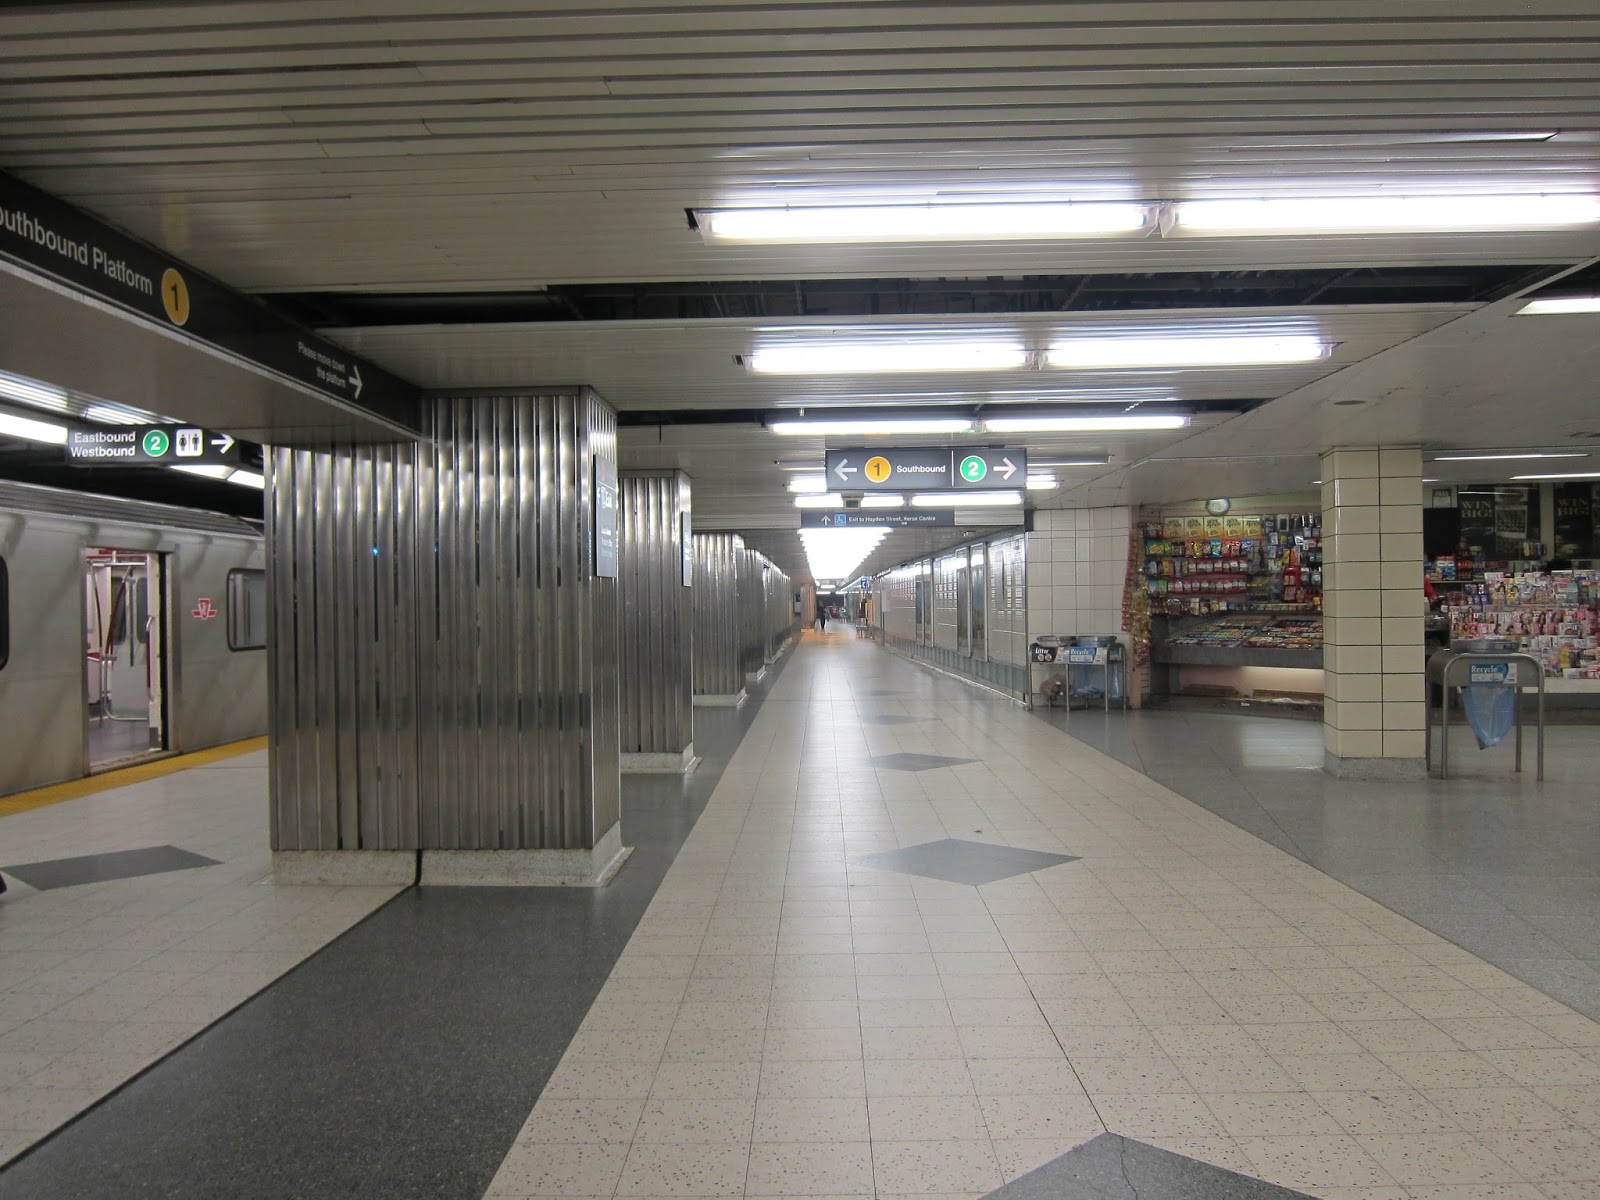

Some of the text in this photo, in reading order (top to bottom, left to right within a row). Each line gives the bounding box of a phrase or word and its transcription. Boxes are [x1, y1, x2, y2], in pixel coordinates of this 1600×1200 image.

[92, 247, 153, 295] Platform
[171, 283, 179, 312] 1
[298, 341, 317, 361] Please
[74, 432, 136, 444] Eastbound
[151, 436, 161, 450] 2
[71, 445, 136, 458] Westbound
[873, 463, 946, 477] 1 Southbound
[967, 462, 979, 476] 2
[1461, 500, 1491, 509] WIN
[1557, 498, 1590, 507] WIN
[1461, 509, 1493, 518] BIG!
[1557, 507, 1590, 516] BIG!
[865, 516, 885, 524] Hayden
[1471, 665, 1498, 674] Recycle
